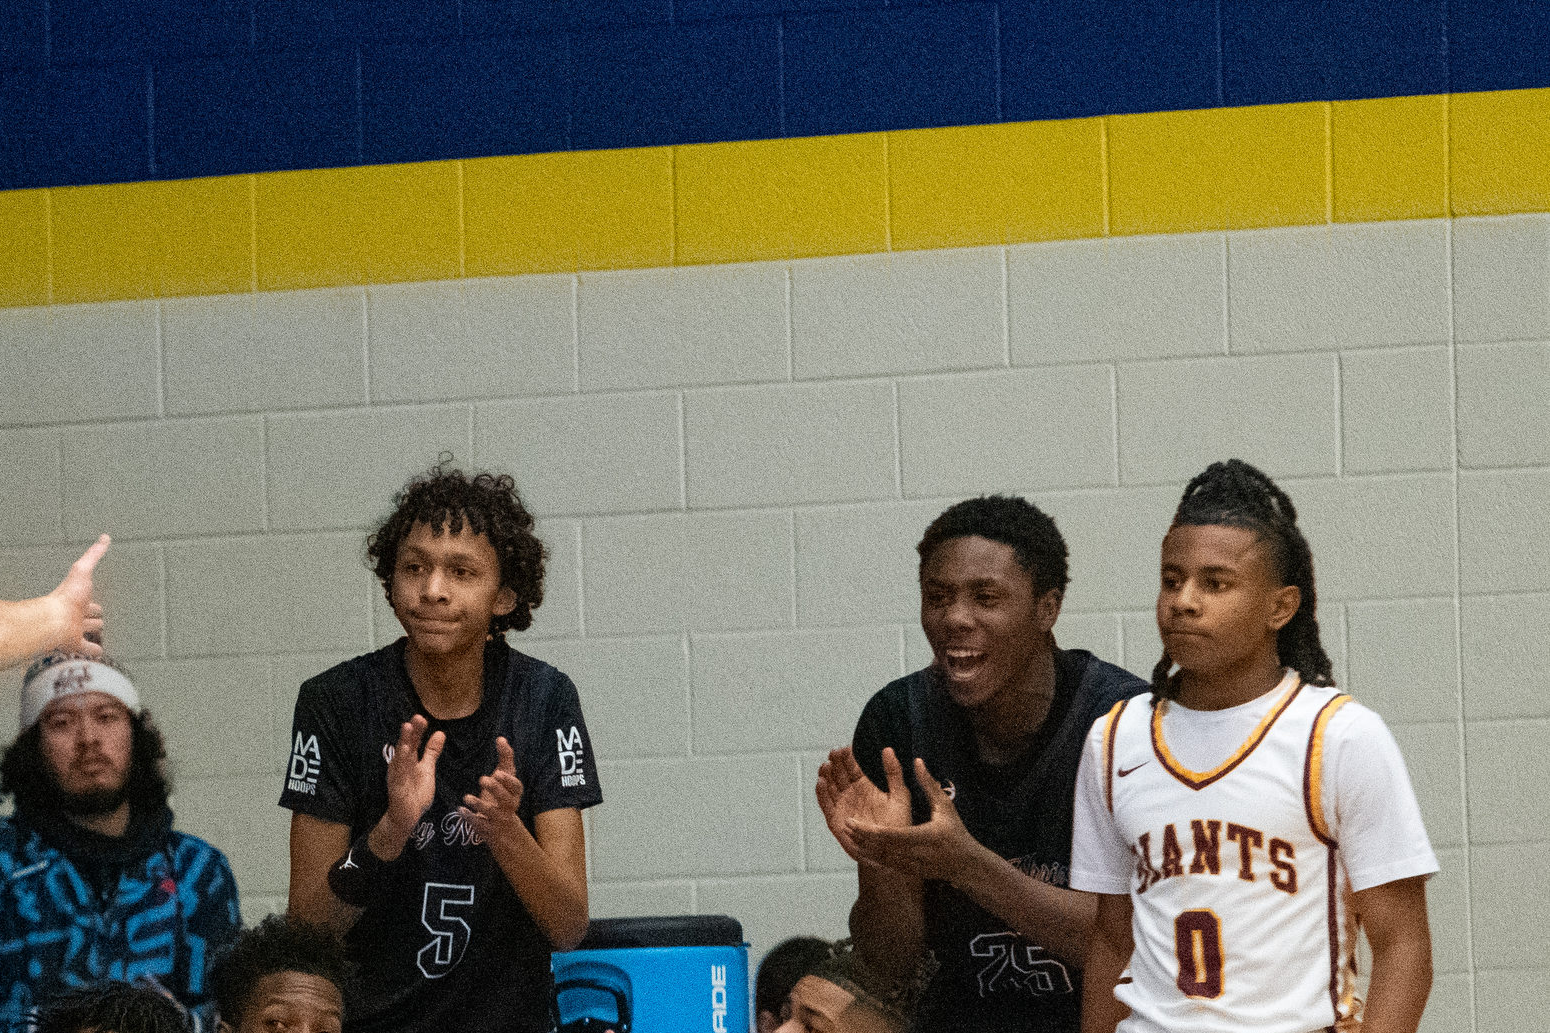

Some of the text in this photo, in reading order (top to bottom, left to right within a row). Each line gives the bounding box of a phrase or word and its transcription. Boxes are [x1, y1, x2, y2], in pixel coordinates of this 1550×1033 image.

[287, 778, 316, 796] HOOPS
[416, 881, 475, 979] 5
[1174, 907, 1226, 1000] 0
